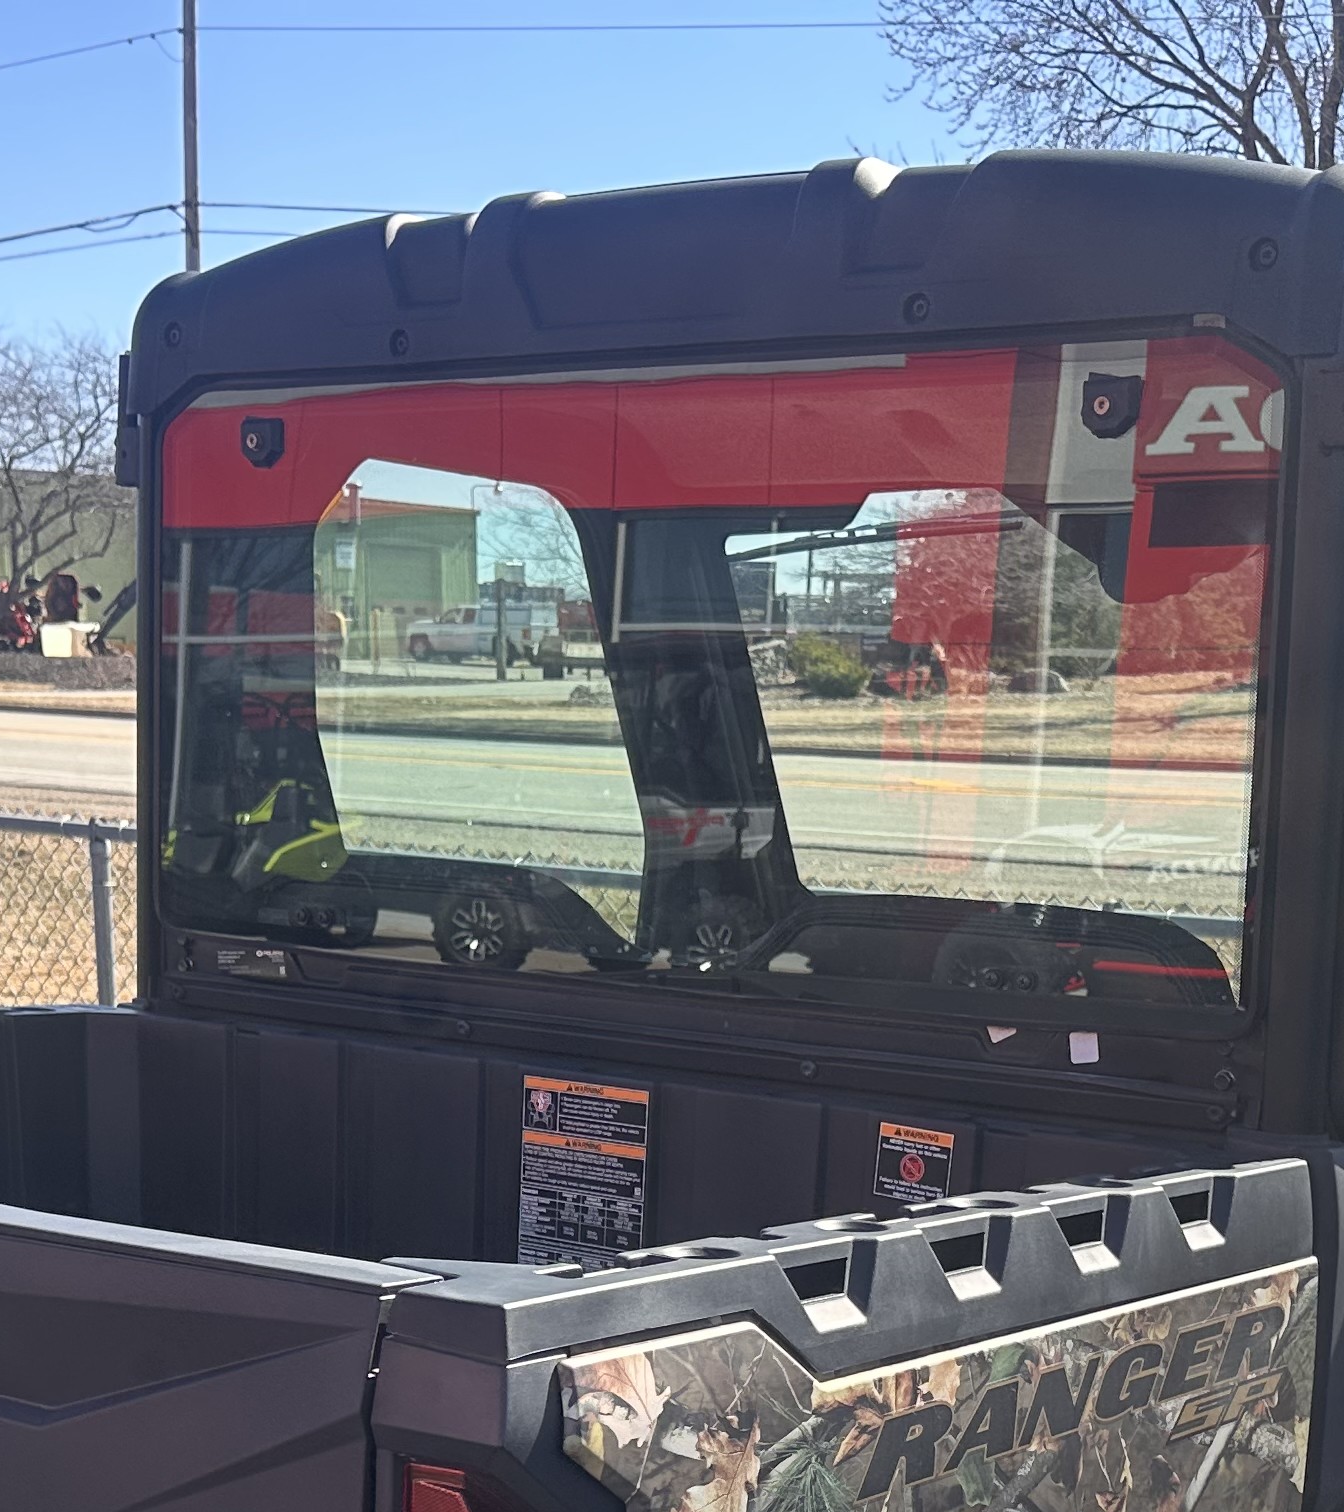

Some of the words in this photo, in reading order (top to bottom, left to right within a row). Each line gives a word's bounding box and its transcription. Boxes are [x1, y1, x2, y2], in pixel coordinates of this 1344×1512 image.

[573, 1084, 605, 1096] WARNING
[903, 1129, 939, 1143] WARNING
[571, 1140, 602, 1152] WARNING
[854, 1306, 1286, 1506] RANGER
[1167, 1366, 1290, 1444] SP
